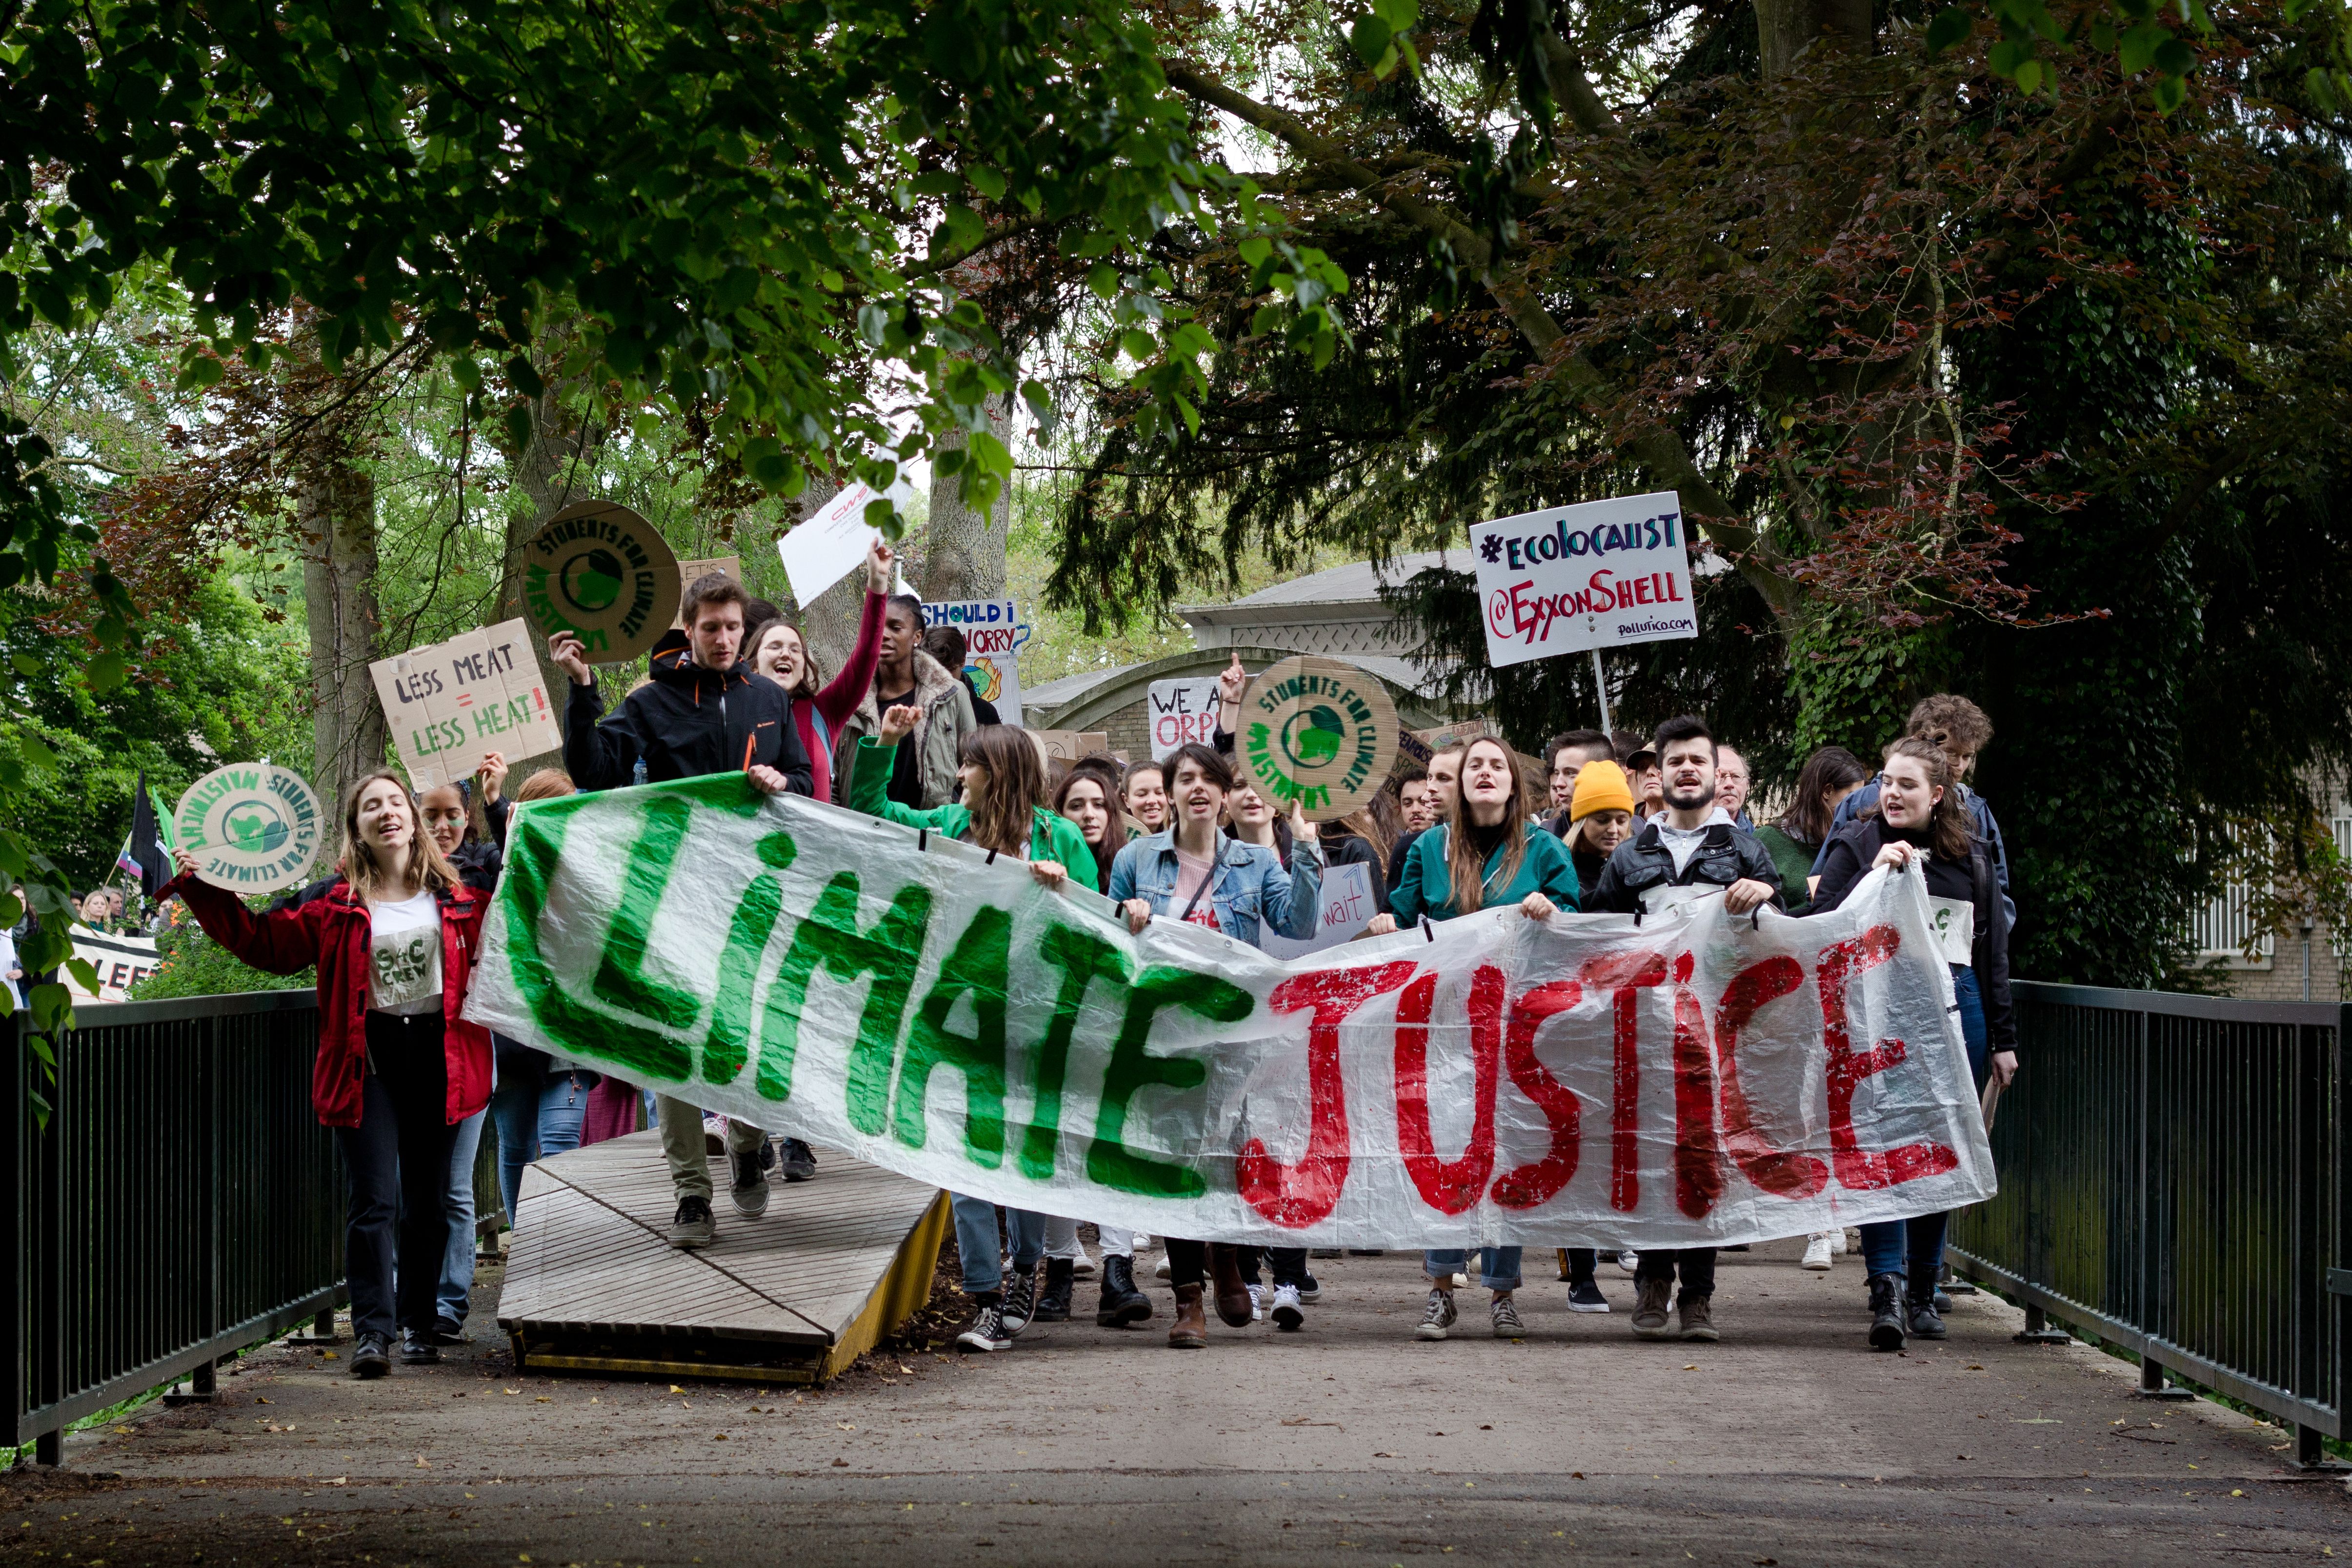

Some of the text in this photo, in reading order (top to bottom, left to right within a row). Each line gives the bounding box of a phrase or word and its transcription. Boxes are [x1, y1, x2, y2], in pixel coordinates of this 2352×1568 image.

[832, 484, 867, 521] CWS
[538, 520, 655, 639] STUDENTS FOR CLIMATE
[921, 603, 1001, 625] SHOULD
[395, 643, 514, 704] LESS MEAT
[1151, 688, 1191, 714] WE
[412, 687, 547, 757] LESS HEAT!
[1156, 712, 1220, 747] ORP
[1258, 675, 1376, 794] STUDENTS FOR CLIMATE
[180, 770, 260, 851] MAASTRICHT
[205, 774, 315, 883] STUDENTS FOR CLIMATE
[1323, 880, 1363, 927] wait
[382, 963, 426, 986] CREW
[501, 771, 1959, 1228] CLiMATE JUSTiCE
